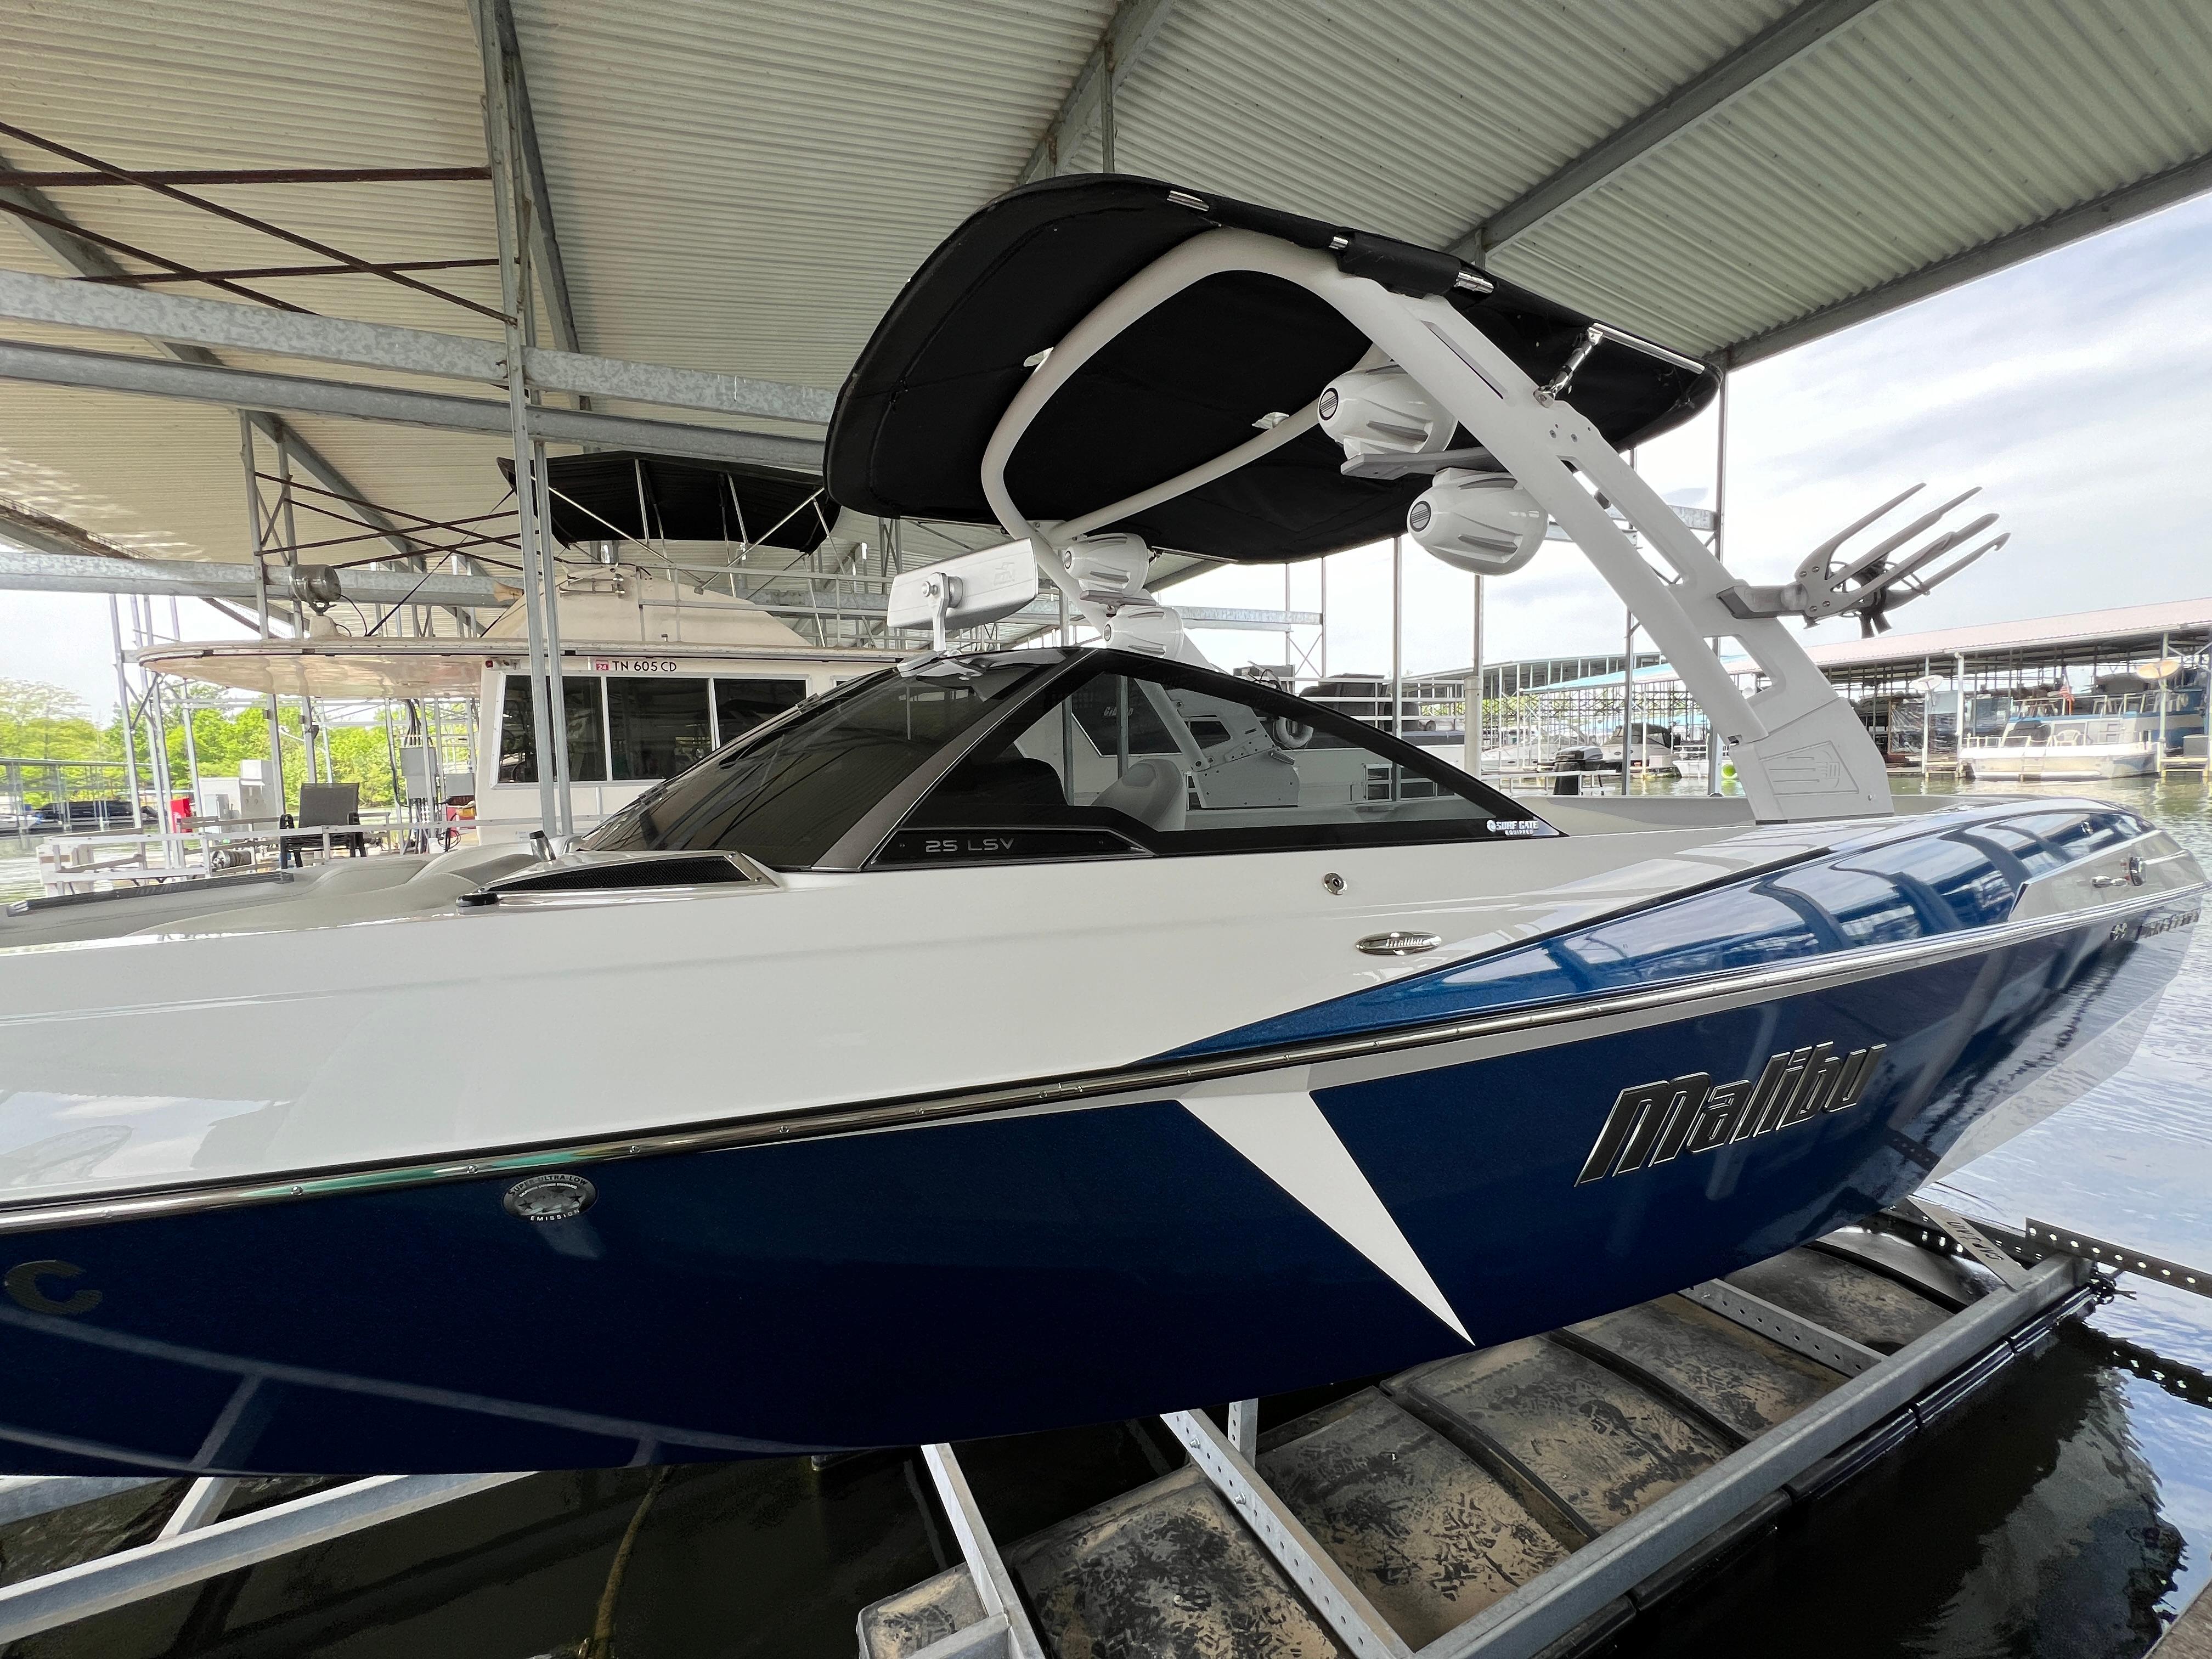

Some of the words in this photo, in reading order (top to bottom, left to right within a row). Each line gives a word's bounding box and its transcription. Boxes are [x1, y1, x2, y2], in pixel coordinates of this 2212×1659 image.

[612, 661, 629, 671] TN
[634, 661, 658, 672] 605
[661, 662, 676, 672] CD
[1496, 821, 1517, 831] SURF
[1519, 820, 1539, 830] GATE
[926, 840, 958, 853] 25
[967, 838, 1014, 851] LSV
[1574, 1041, 1887, 1188] Malibu
[530, 1209, 580, 1221] EMISSION
